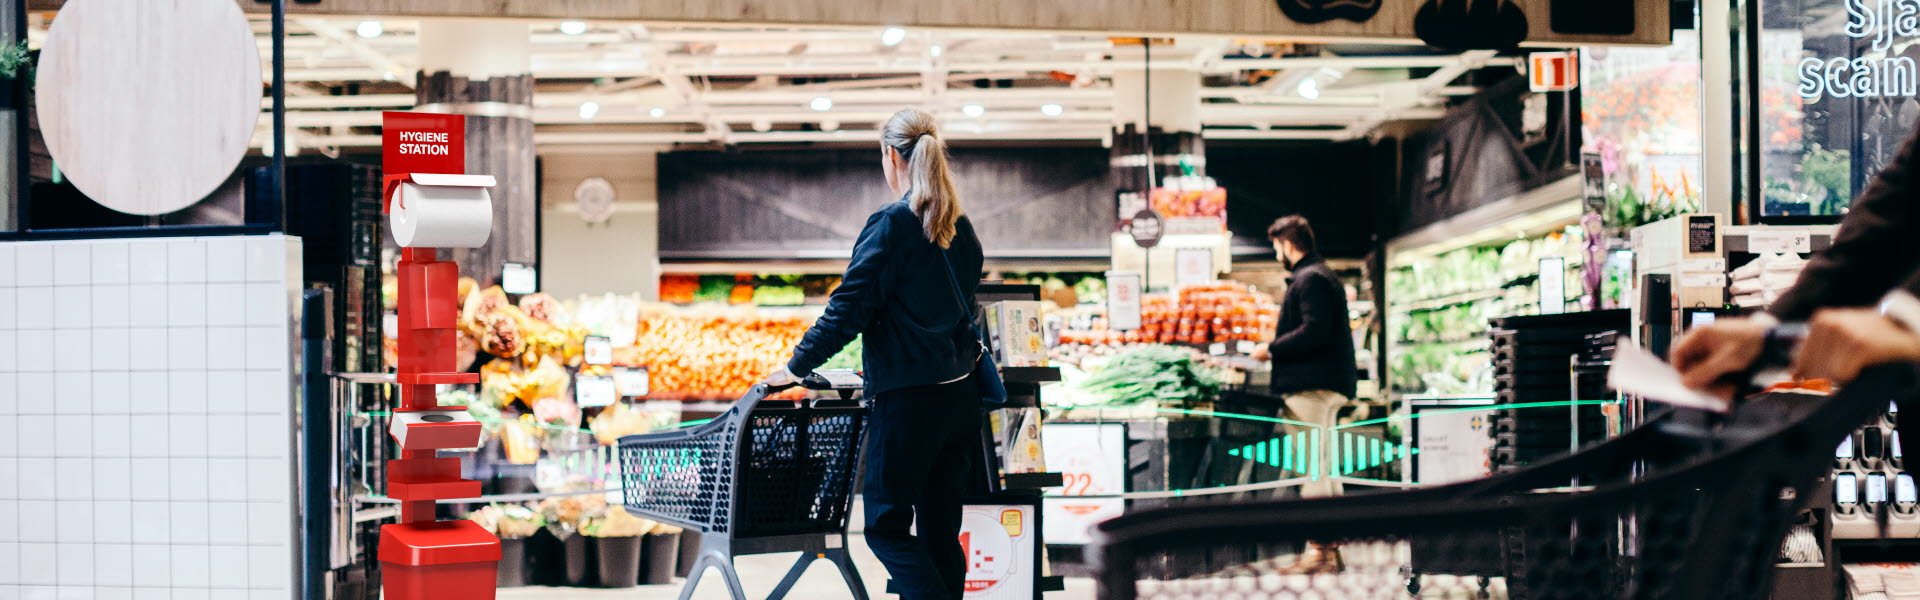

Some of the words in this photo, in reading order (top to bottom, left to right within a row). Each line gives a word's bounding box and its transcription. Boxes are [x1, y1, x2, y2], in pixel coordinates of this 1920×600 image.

[1797, 56, 1917, 98] scan
[399, 131, 449, 143] HYGIENE
[399, 143, 449, 156] STATION
